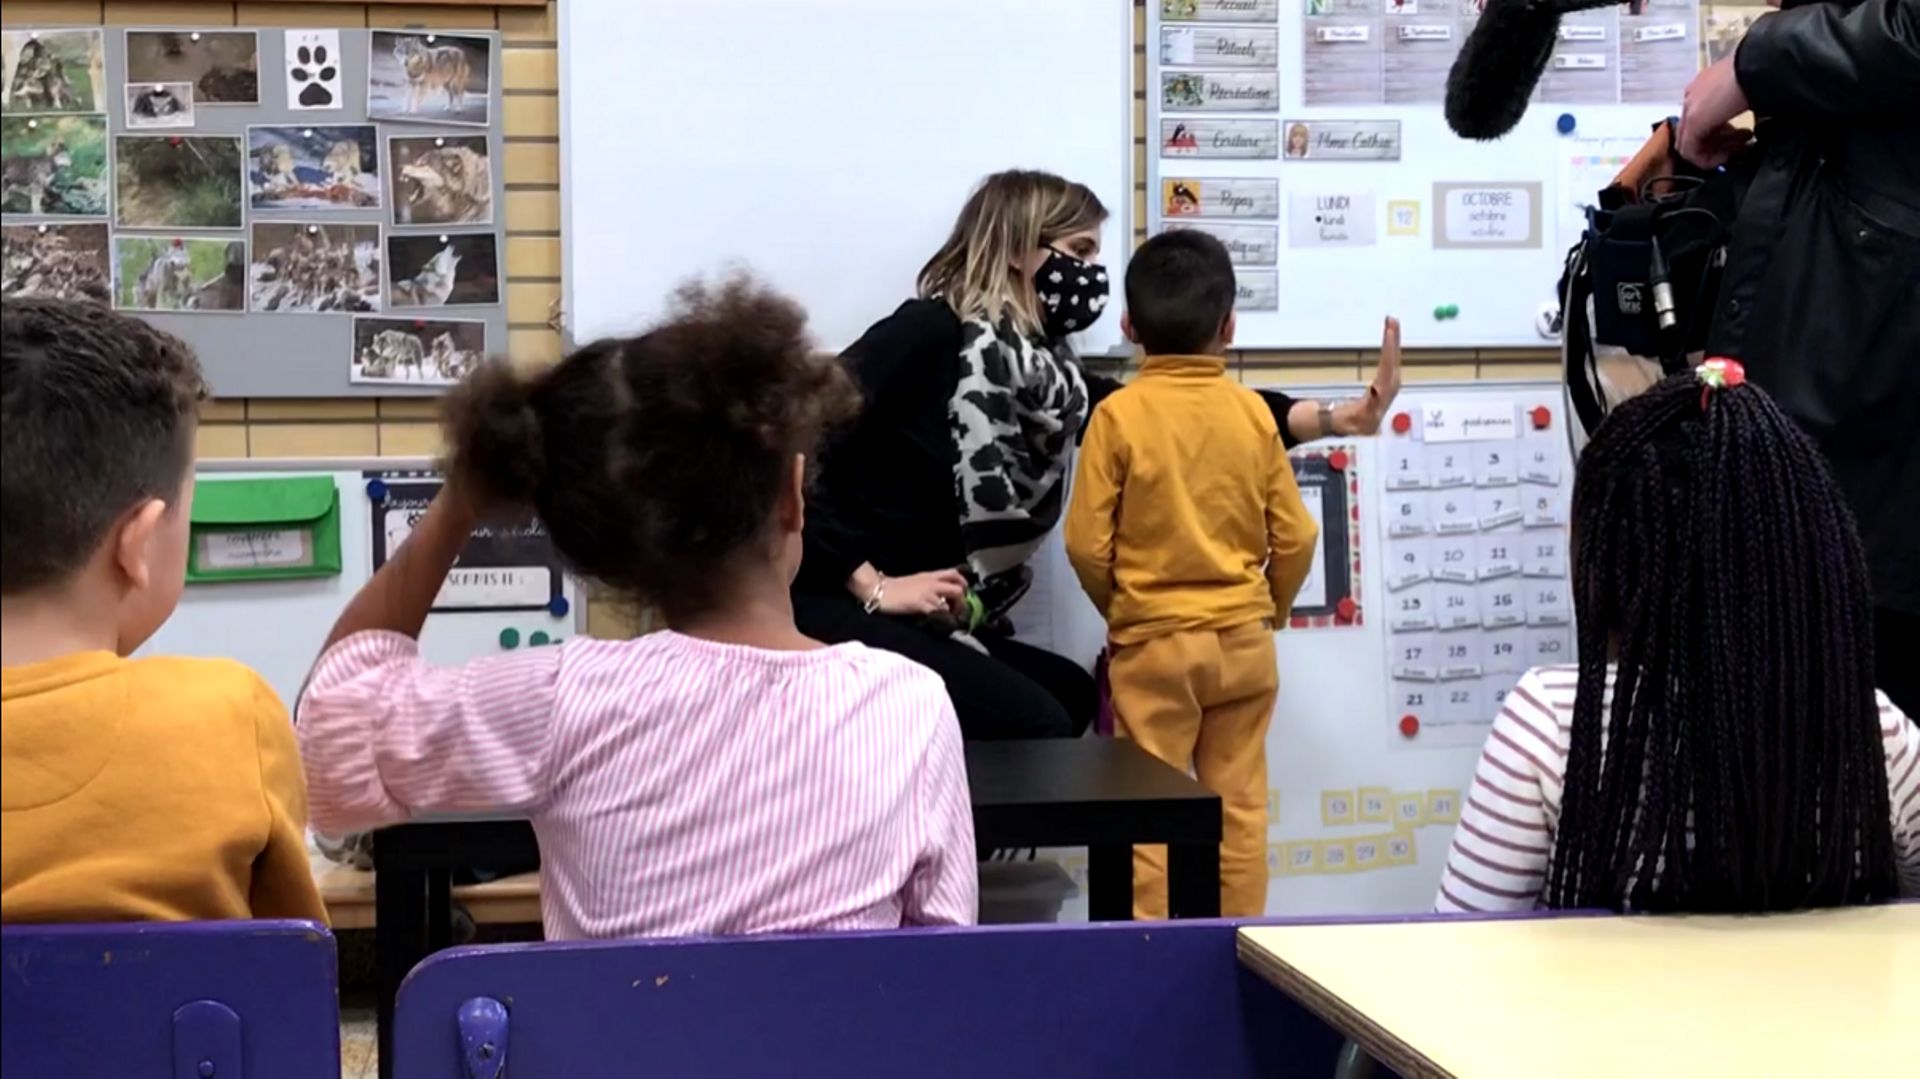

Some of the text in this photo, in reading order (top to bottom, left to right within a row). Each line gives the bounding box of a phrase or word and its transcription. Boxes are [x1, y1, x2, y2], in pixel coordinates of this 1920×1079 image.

[1316, 196, 1350, 211] LUNDI
[1462, 191, 1513, 206] OCTOBRE
[1400, 458, 1408, 471] 1
[1444, 456, 1453, 468] 2
[1488, 453, 1500, 465] 3
[1493, 500, 1502, 512] 7
[1404, 546, 1554, 564] 9 10 11 12
[1402, 598, 1421, 610] 13
[1494, 594, 1512, 606] 15
[1538, 592, 1557, 604] 16
[1405, 641, 1561, 660] 17 18 19 20
[1406, 694, 1423, 706] 21
[1451, 691, 1469, 703] 22
